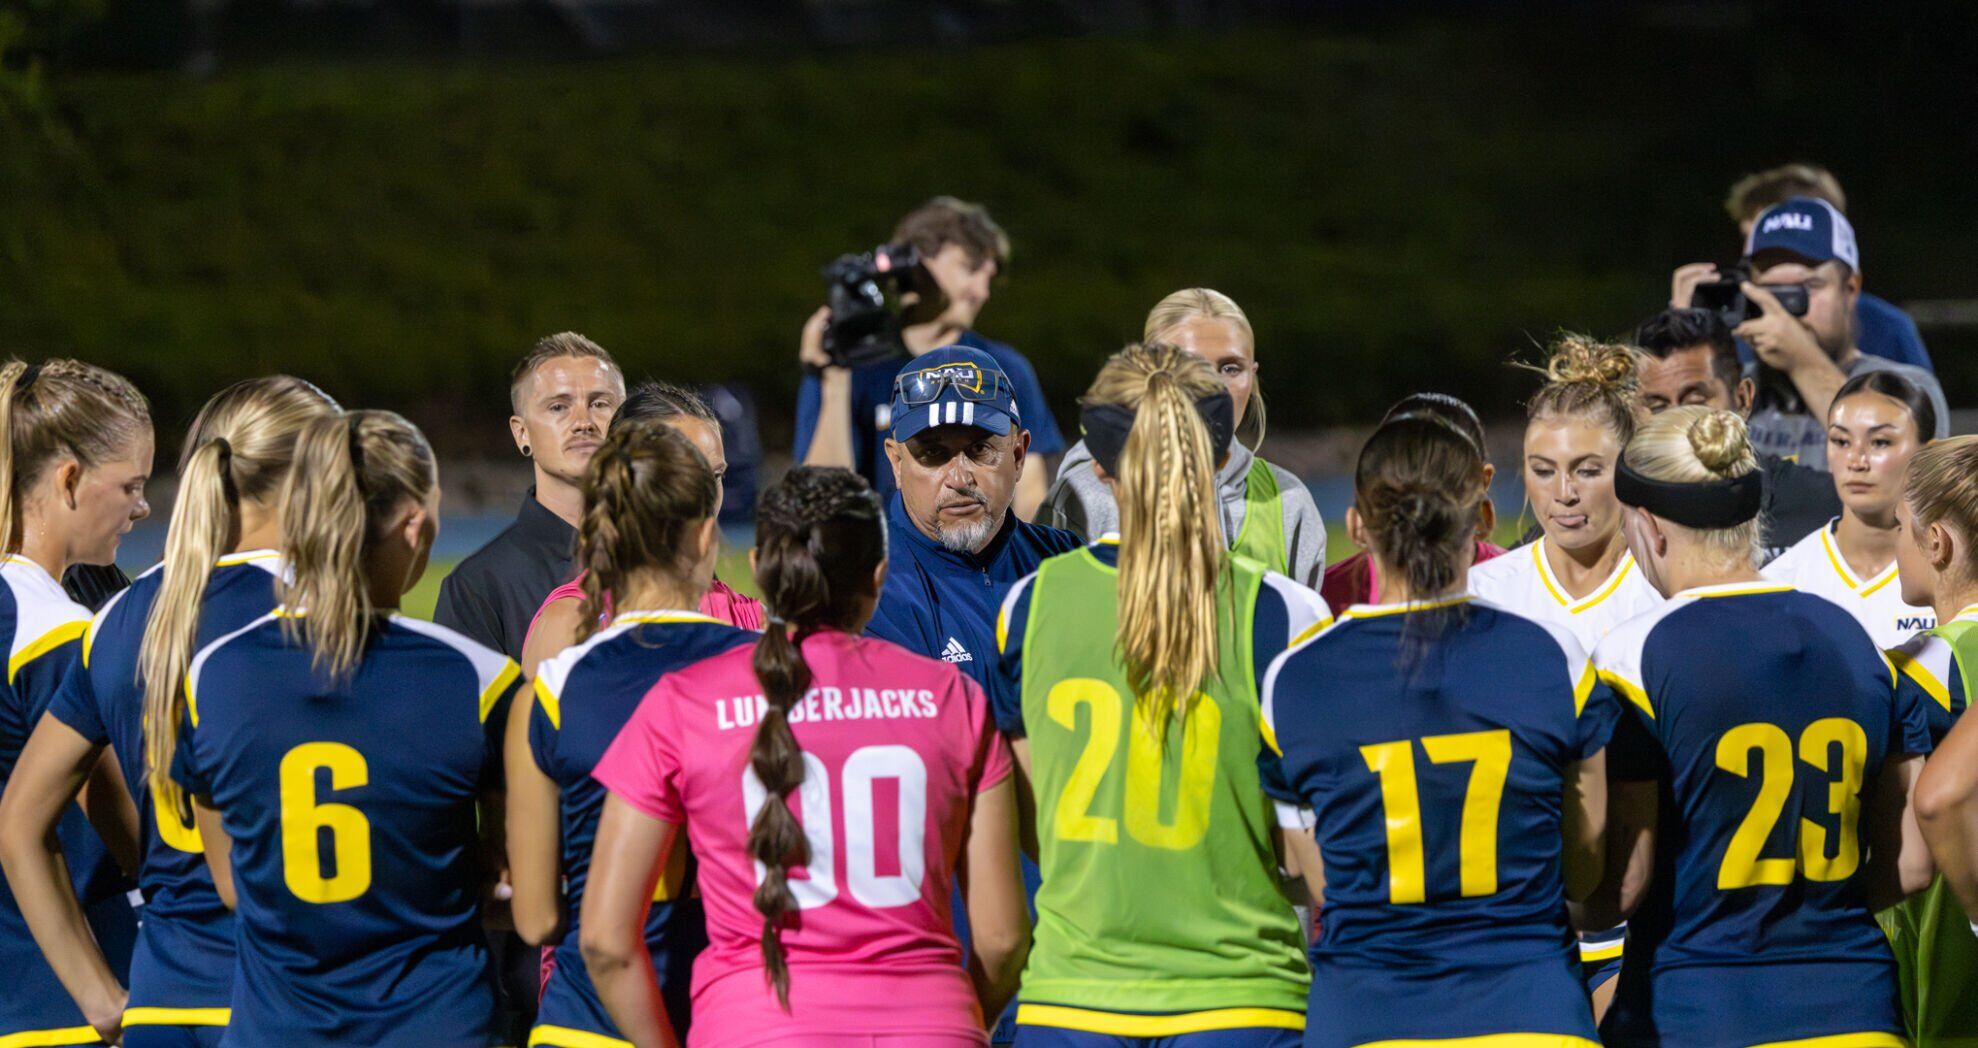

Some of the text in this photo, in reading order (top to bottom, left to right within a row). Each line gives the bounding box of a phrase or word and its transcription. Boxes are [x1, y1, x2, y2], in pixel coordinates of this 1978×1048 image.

[1896, 618, 1935, 631] NAU
[279, 741, 372, 904] 6
[1047, 677, 1222, 851] 20
[1359, 729, 1512, 904] 17
[1716, 717, 1867, 890] 23
